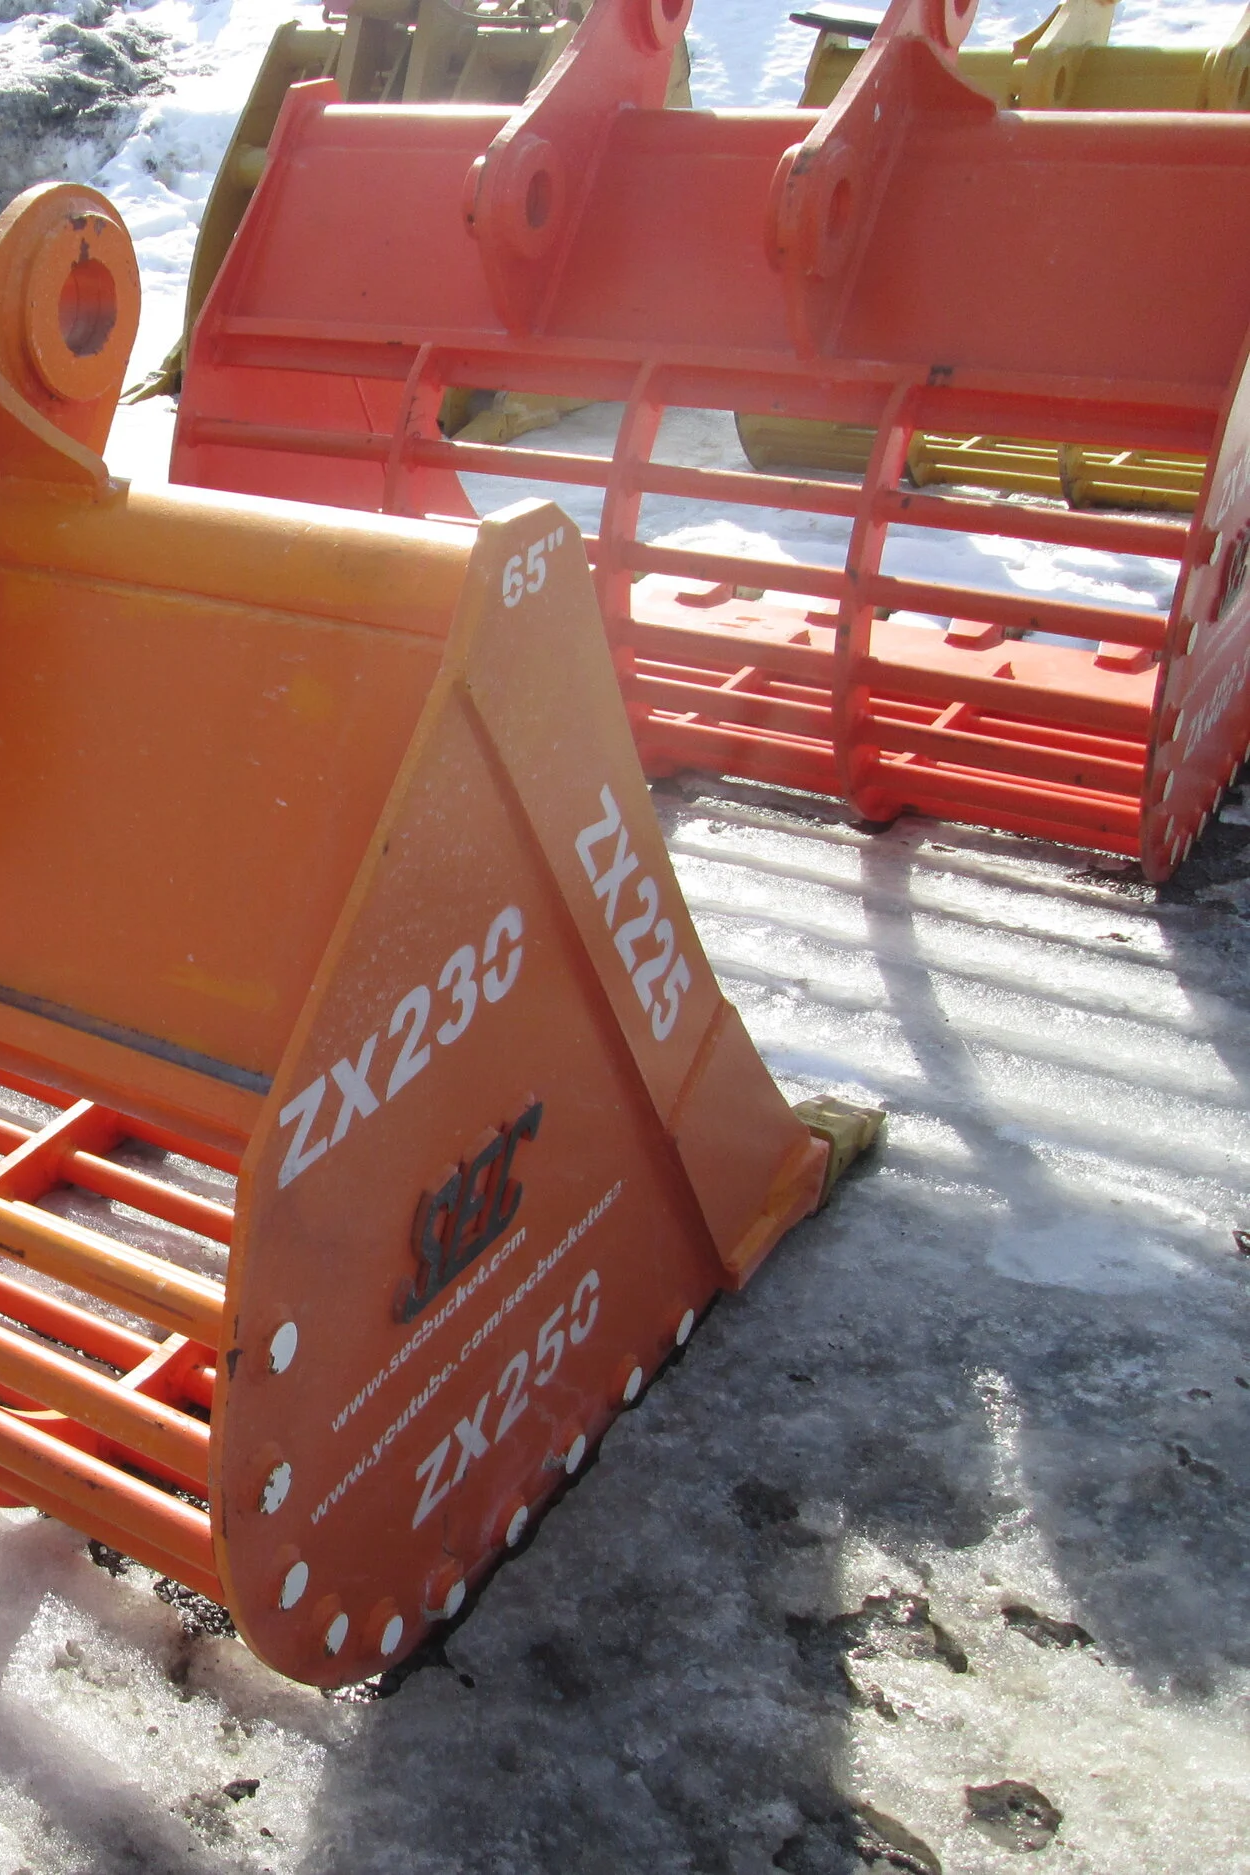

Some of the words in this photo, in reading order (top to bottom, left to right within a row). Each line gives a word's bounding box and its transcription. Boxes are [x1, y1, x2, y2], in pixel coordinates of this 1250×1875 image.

[502, 525, 565, 609] 65"
[574, 783, 692, 1042] ZX225
[277, 904, 523, 1191] ZX230
[330, 1226, 527, 1433] www.secbucket.com
[394, 1101, 544, 1325] SEC
[411, 1268, 600, 1531] ZX250
